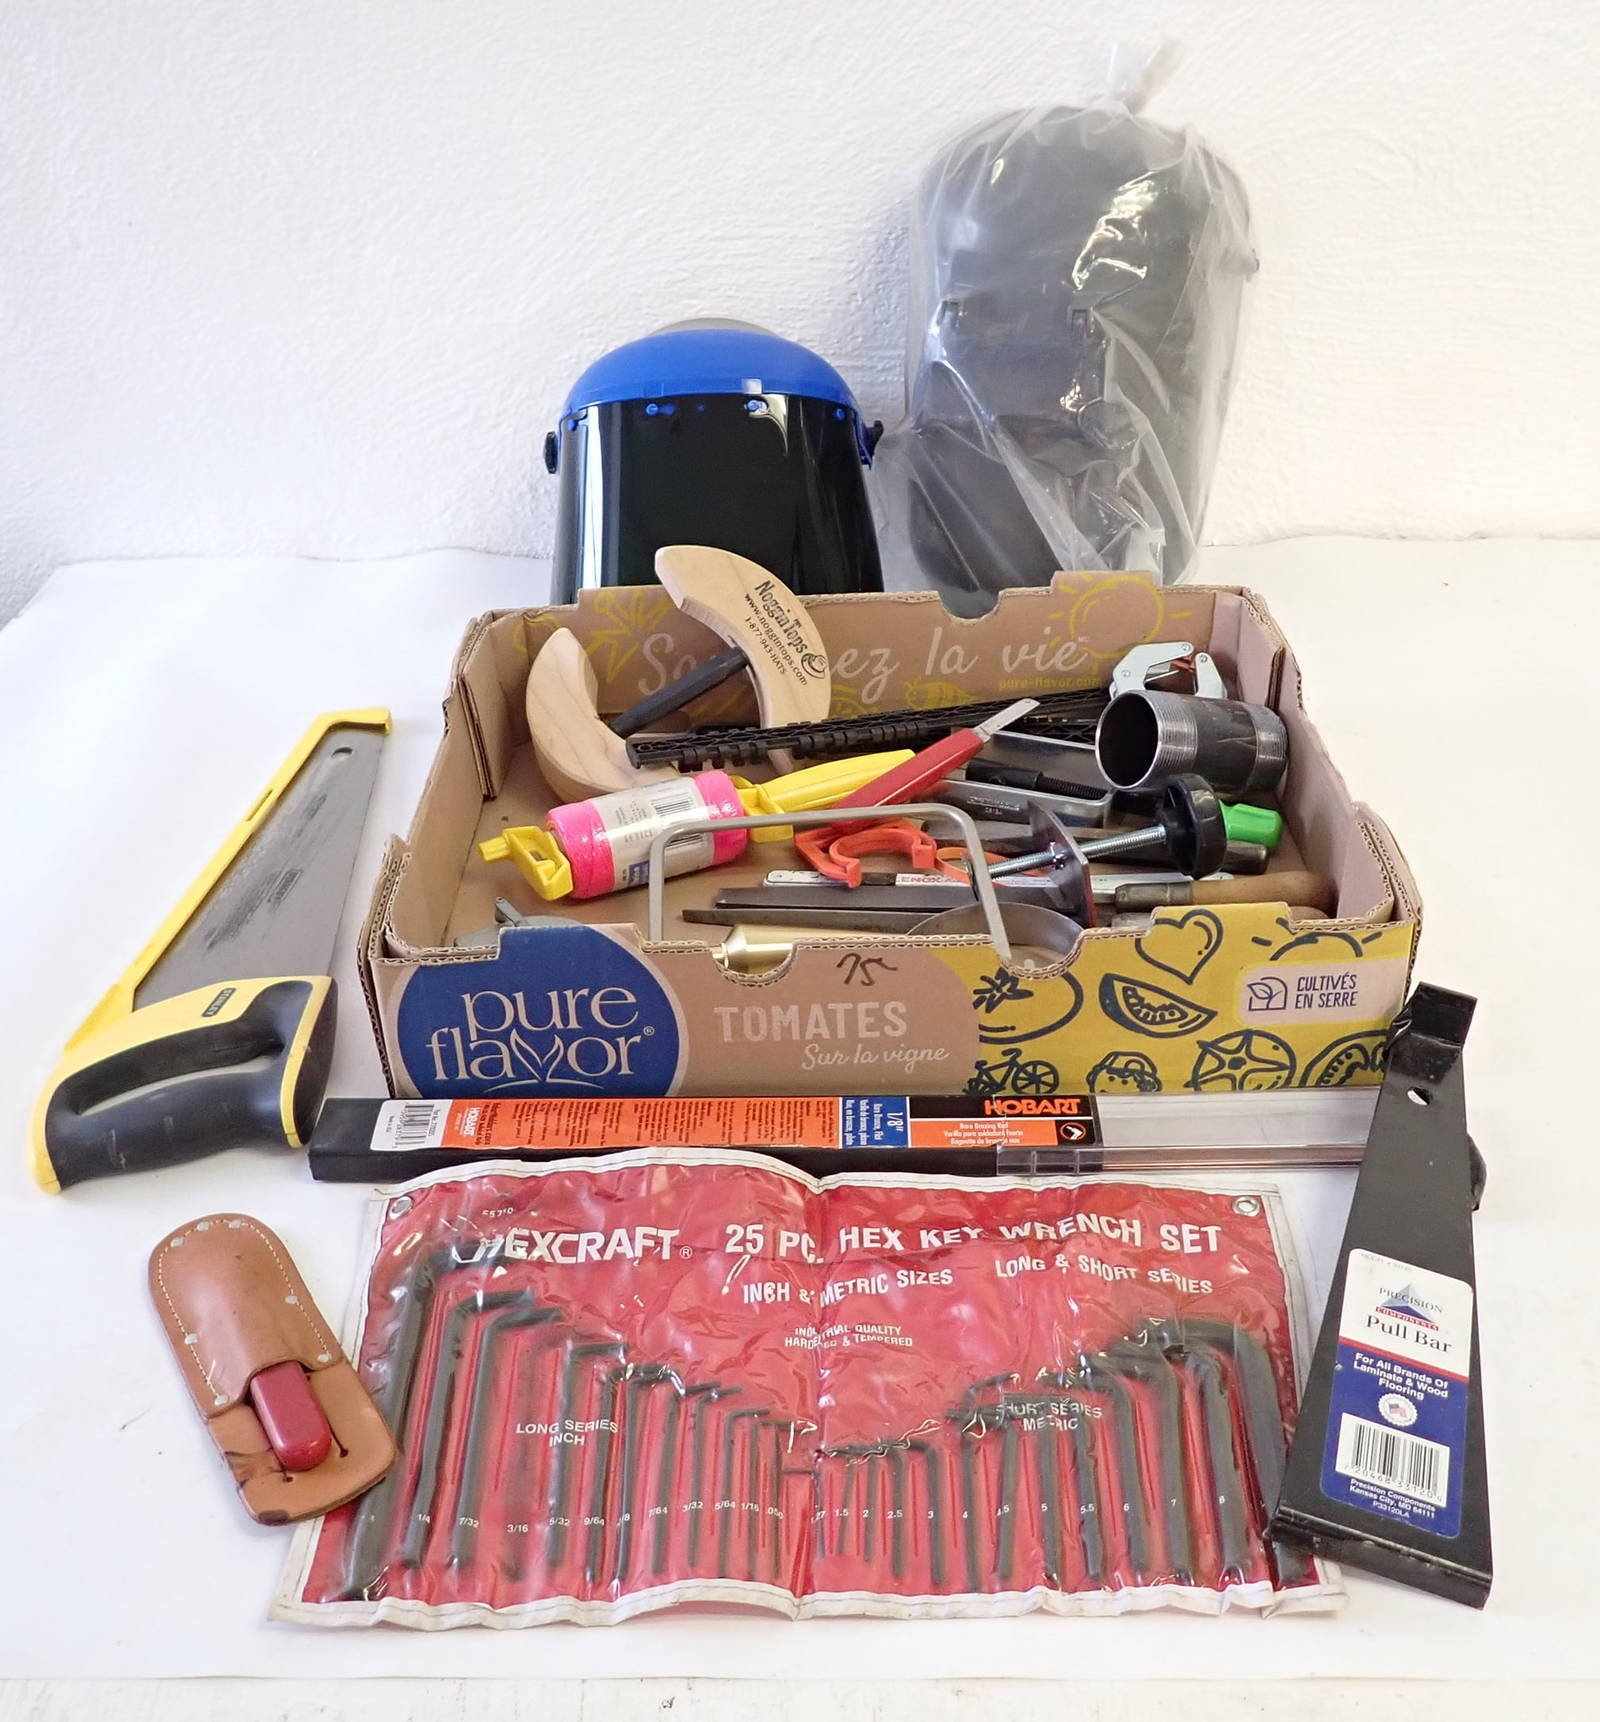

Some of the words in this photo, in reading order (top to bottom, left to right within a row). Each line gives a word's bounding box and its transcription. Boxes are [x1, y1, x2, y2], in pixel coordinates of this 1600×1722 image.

[754, 580, 808, 654] NogginTops
[745, 593, 808, 686] www.noggintops.com
[925, 626, 979, 675] la
[1002, 626, 1088, 673] vie
[1297, 971, 1358, 992] CULTIVÉS
[1295, 993, 1314, 1009] EN
[1318, 991, 1358, 1008] SERRE
[461, 986, 640, 1041] pure
[714, 1001, 908, 1042] TOMATES
[802, 1043, 850, 1071] Sur
[853, 1043, 879, 1064] la
[882, 1043, 952, 1074] vigne
[985, 1098, 1081, 1116] HOBART
[725, 1224, 764, 1254] 25
[779, 1230, 824, 1264] PC.
[839, 1226, 905, 1254] HEX
[919, 1226, 983, 1249] KEY
[999, 1213, 1142, 1249] WRENCH
[1160, 1223, 1221, 1254] SET
[995, 1253, 1046, 1279] LONG
[1056, 1253, 1069, 1274] &
[1078, 1257, 1137, 1282] SHORT
[1148, 1269, 1213, 1295] SERIES
[743, 1282, 790, 1305] INCH
[819, 1274, 889, 1309] METRIC
[897, 1269, 953, 1289] SIZES
[1379, 1287, 1443, 1313] PRECISION
[842, 1336, 851, 1348] &
[853, 1333, 913, 1348] TEMPERED
[855, 1324, 901, 1336] QUALITY
[1366, 1315, 1408, 1339] Pull
[1415, 1330, 1452, 1353] Bar
[1353, 1361, 1403, 1382] Laminate
[1405, 1376, 1414, 1387] &
[1416, 1380, 1449, 1398] Wood
[1355, 1352, 1374, 1366] For
[1376, 1358, 1391, 1371] All
[1393, 1364, 1433, 1384] Brands
[1434, 1376, 1449, 1389] Of
[1378, 1378, 1425, 1401] Flooring
[516, 1422, 560, 1434] LONG
[564, 1419, 618, 1433] SERIES
[549, 1432, 585, 1447] INCH
[1350, 1485, 1378, 1500] Kansas
[1350, 1478, 1386, 1496] Precision
[1387, 1488, 1436, 1512] Components
[862, 1509, 870, 1518] 2
[887, 1509, 904, 1519] 2.5
[927, 1510, 935, 1519] 3
[962, 1510, 969, 1519] 4
[1041, 1503, 1049, 1513] 5
[1123, 1503, 1130, 1512] 6
[507, 1524, 529, 1533] 3/16
